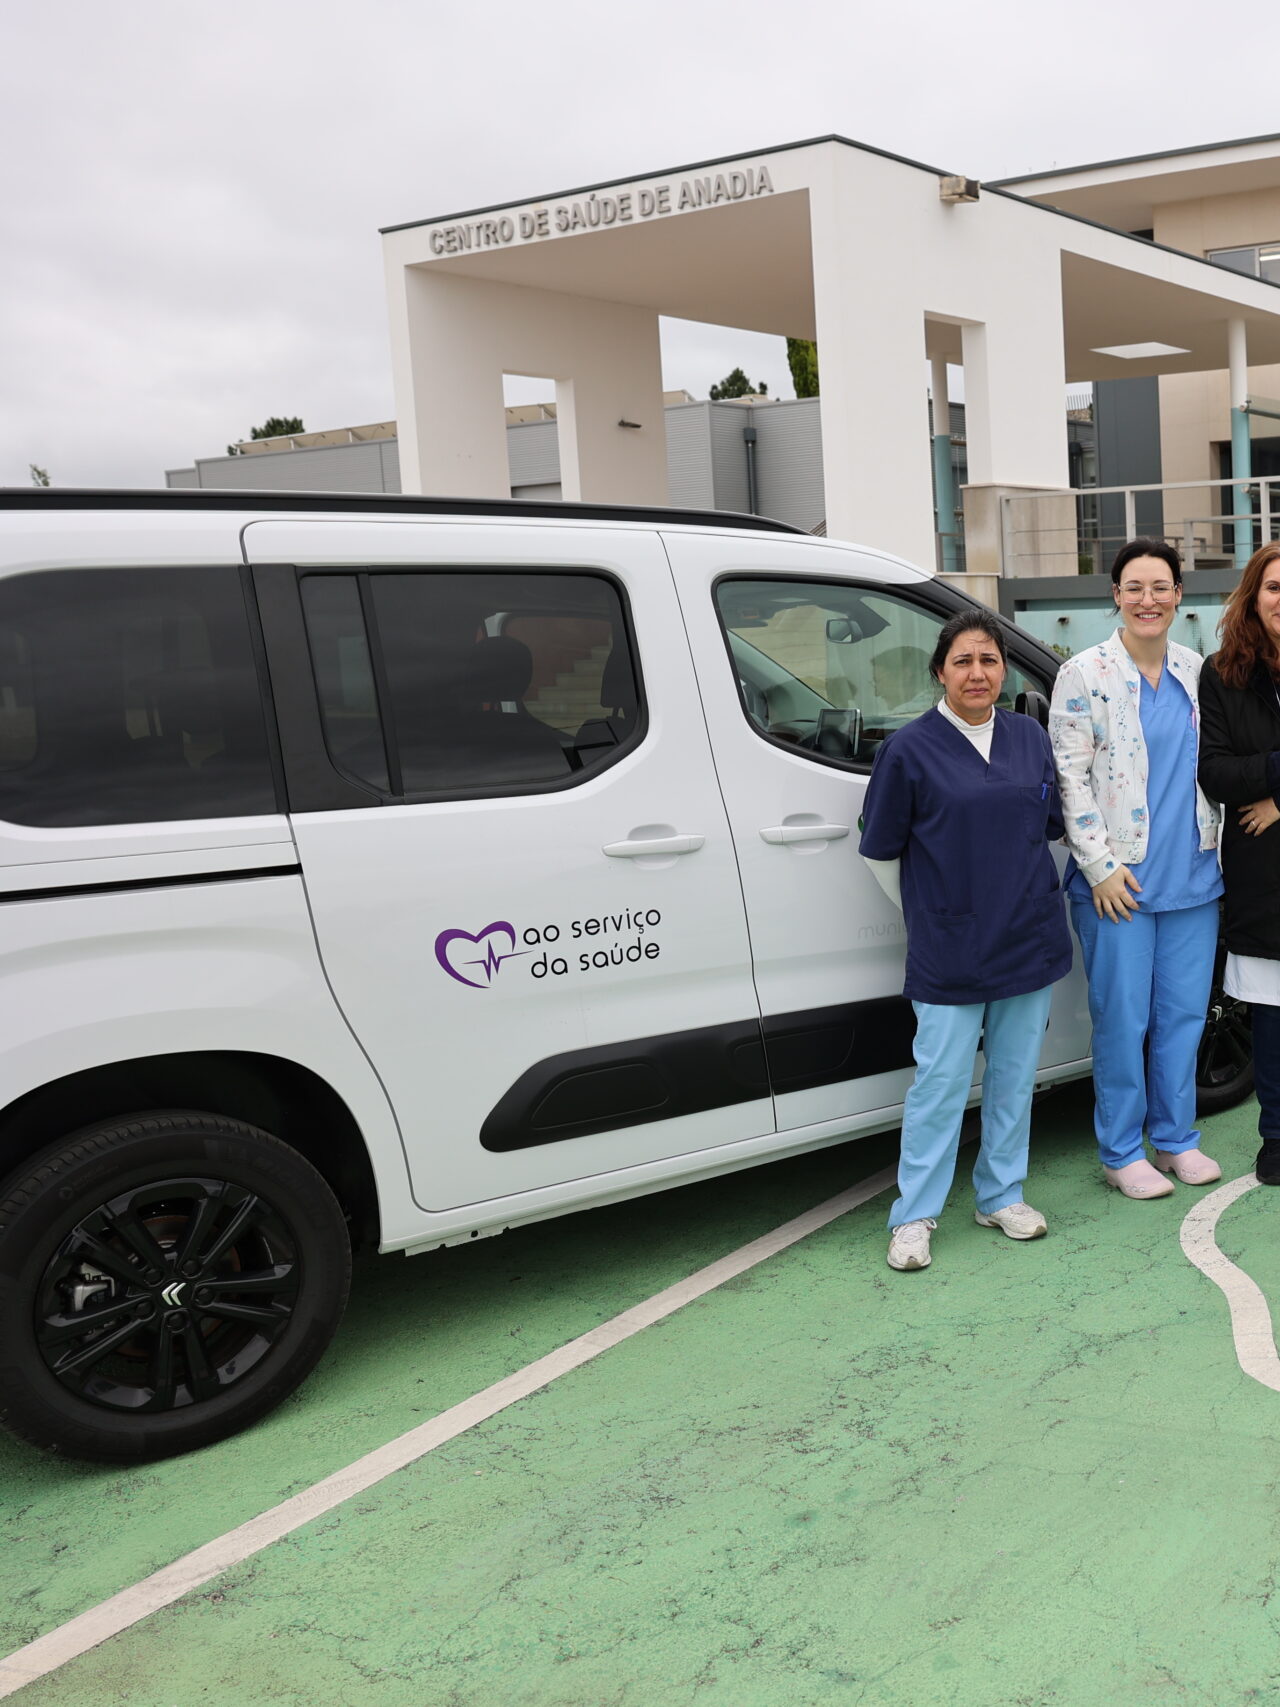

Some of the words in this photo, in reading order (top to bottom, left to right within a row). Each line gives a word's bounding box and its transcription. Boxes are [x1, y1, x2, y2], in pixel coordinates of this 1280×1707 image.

[429, 216, 515, 255] CENTRO
[518, 209, 550, 239] DE
[555, 193, 633, 233] SAÚDE
[637, 185, 671, 217] DE
[677, 166, 774, 210] ANADIA
[523, 924, 561, 945] ao
[571, 908, 661, 939] serviço
[531, 952, 568, 978] da
[579, 937, 660, 971] saúde
